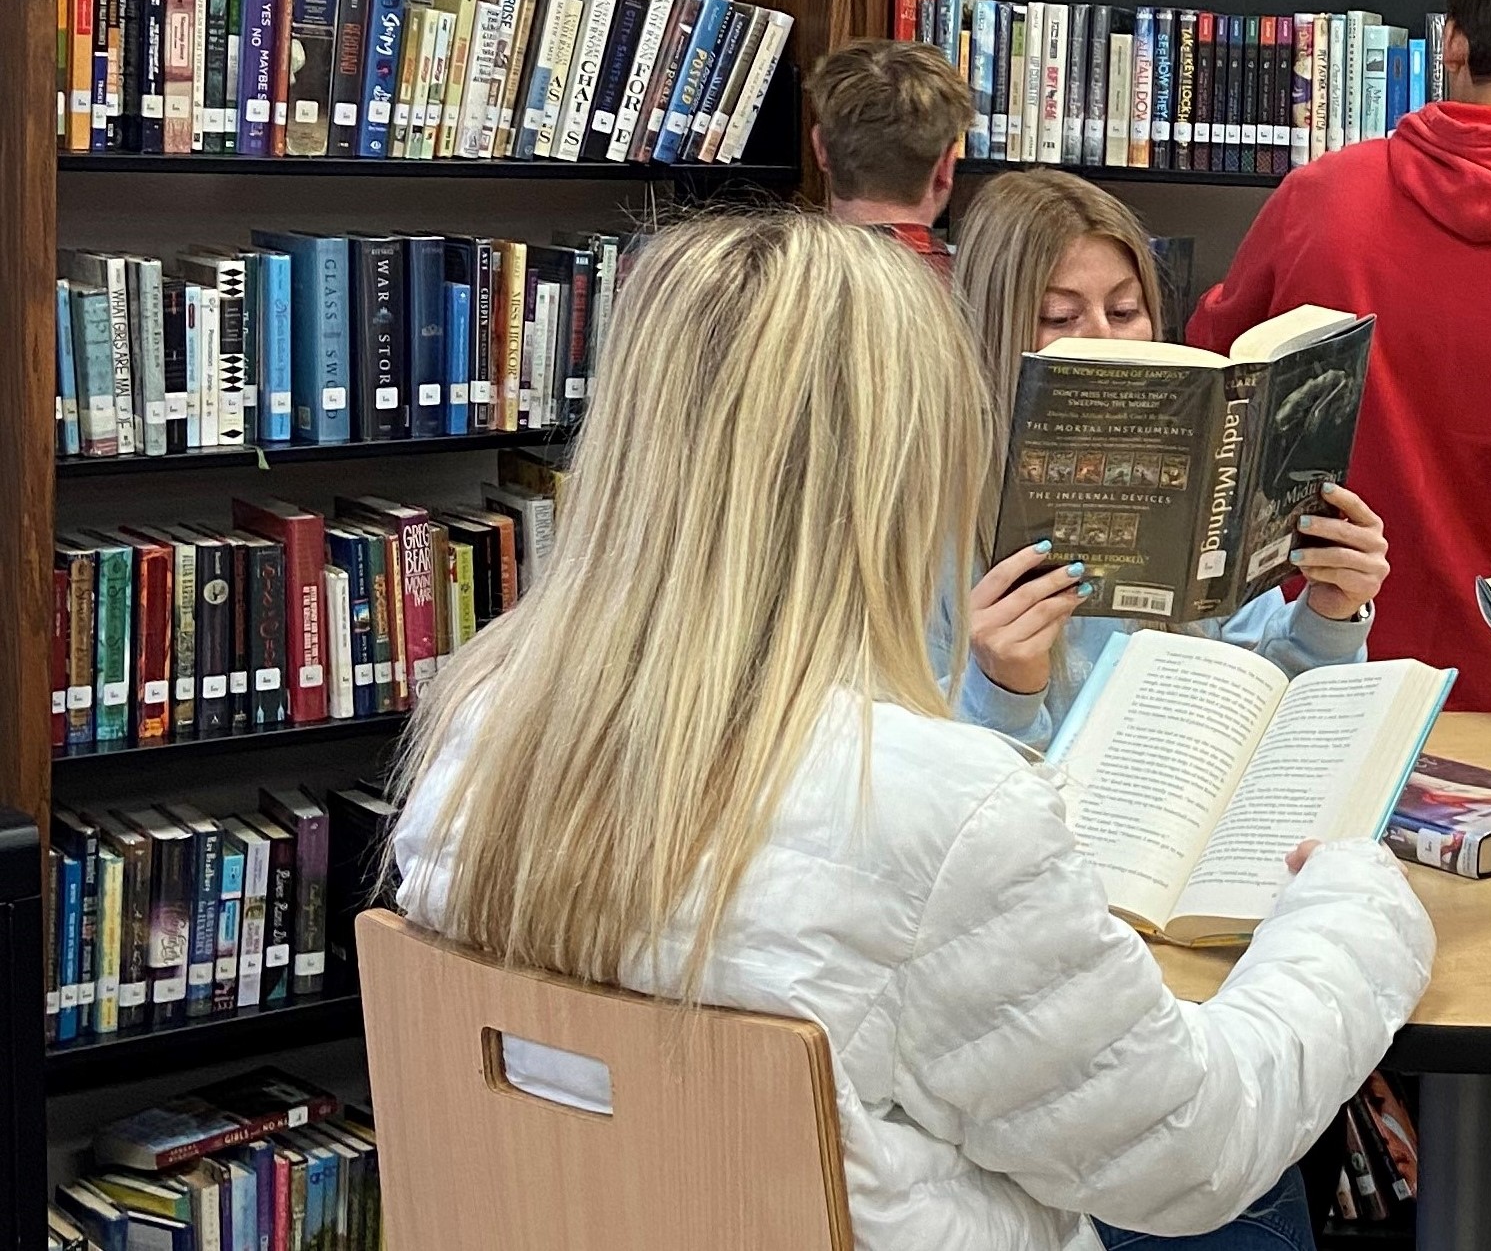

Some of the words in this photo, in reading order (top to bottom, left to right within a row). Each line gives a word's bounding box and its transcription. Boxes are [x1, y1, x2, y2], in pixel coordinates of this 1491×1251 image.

[262, 3, 272, 26] YES
[252, 28, 262, 47] NO
[258, 50, 270, 91] MAYBE
[682, 47, 707, 105] POSTED
[1137, 59, 1149, 85] FALL
[1158, 57, 1170, 86] HOW
[565, 60, 597, 145] CHAIS
[615, 62, 649, 144] FORE
[1137, 90, 1147, 121] DOW
[324, 257, 338, 321] GLASS
[376, 260, 392, 301] WAR
[111, 289, 127, 326] WHAT
[480, 287, 489, 326] CRISPIN
[510, 290, 521, 321] MISS
[113, 322, 128, 351] GIRLS
[115, 351, 130, 376] ARE
[1027, 421, 1049, 432] THE
[1054, 423, 1102, 433] MORTAL
[1108, 425, 1194, 437] INSTRUMENTS
[1215, 399, 1250, 460] Lady
[1029, 491, 1050, 500] THE
[1056, 492, 1114, 501] INFERNAL
[1121, 493, 1172, 505] DEVICES
[403, 524, 430, 550] GREG
[405, 550, 431, 574] BEAR
